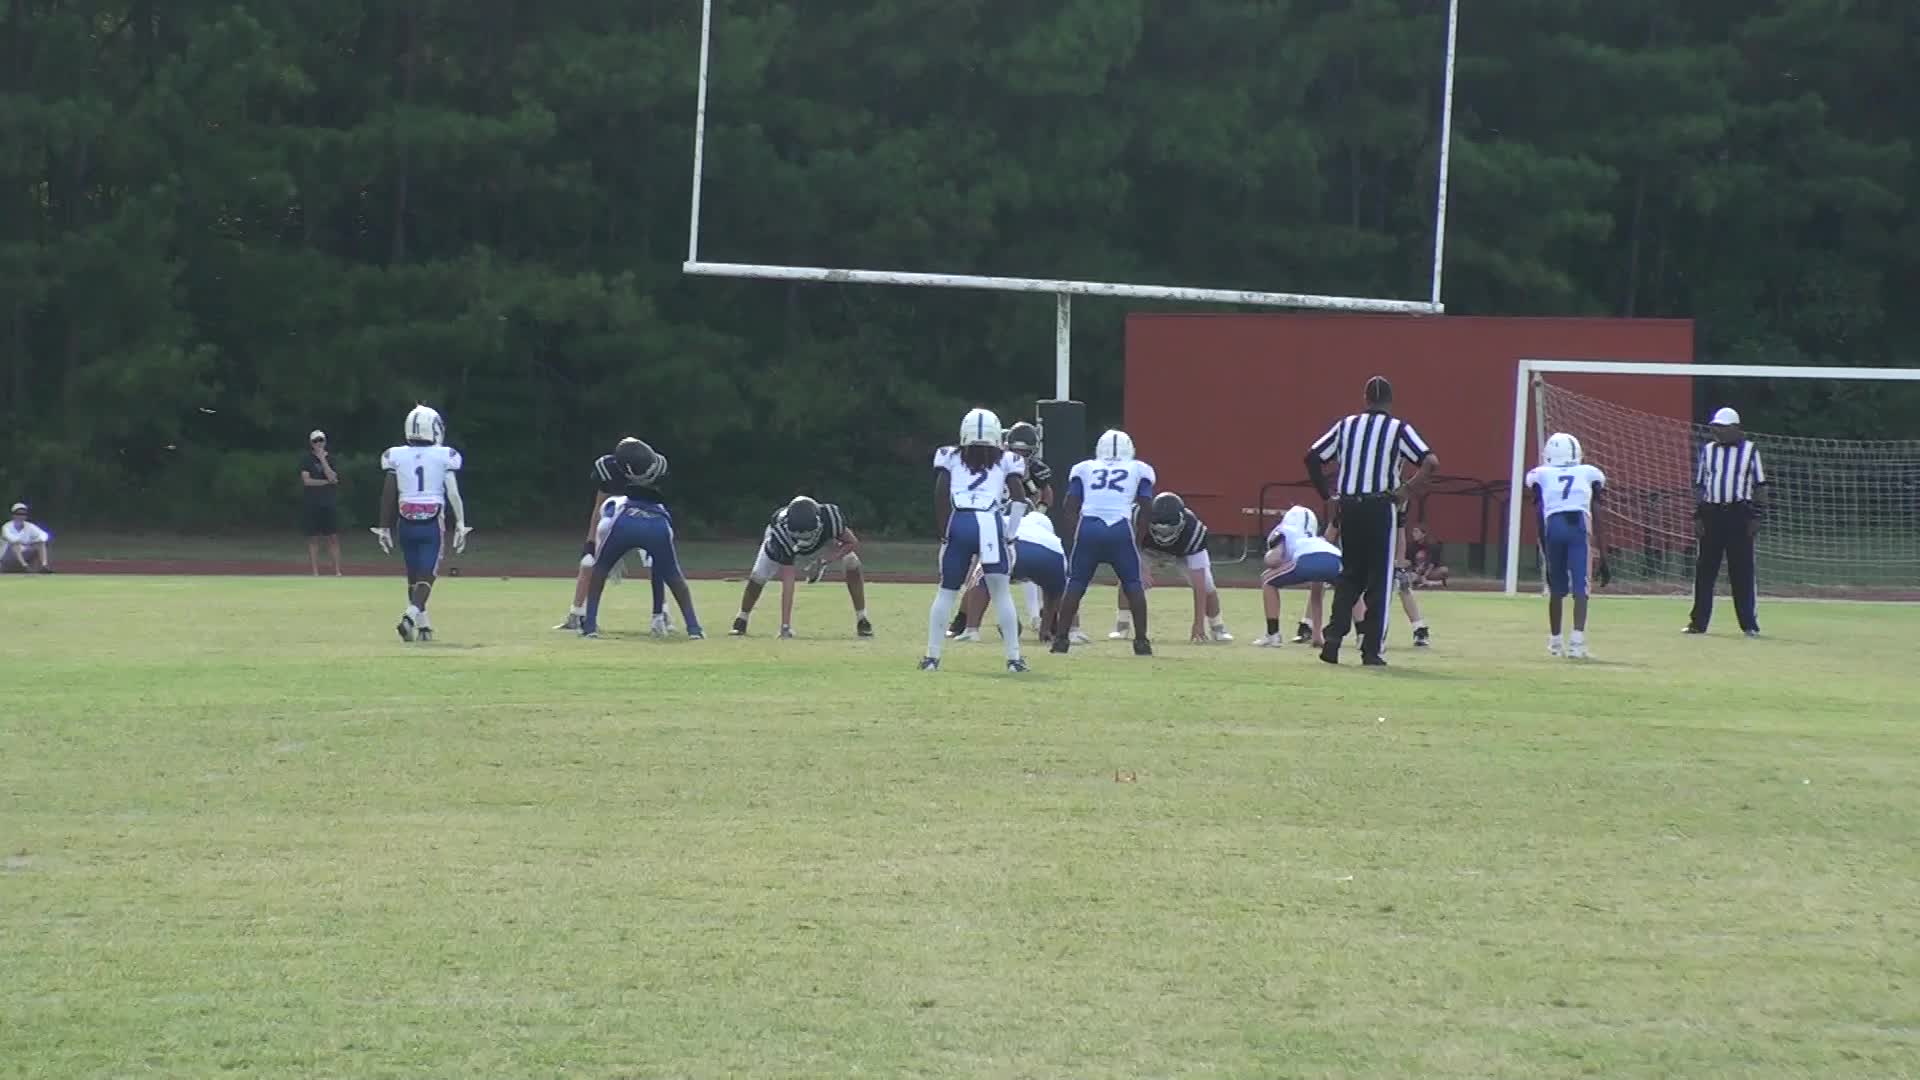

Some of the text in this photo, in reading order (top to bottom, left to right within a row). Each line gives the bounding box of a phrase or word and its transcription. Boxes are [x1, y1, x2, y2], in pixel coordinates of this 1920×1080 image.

[415, 465, 424, 492] 1
[1091, 468, 1129, 493] 32
[1557, 475, 1576, 500] 7
